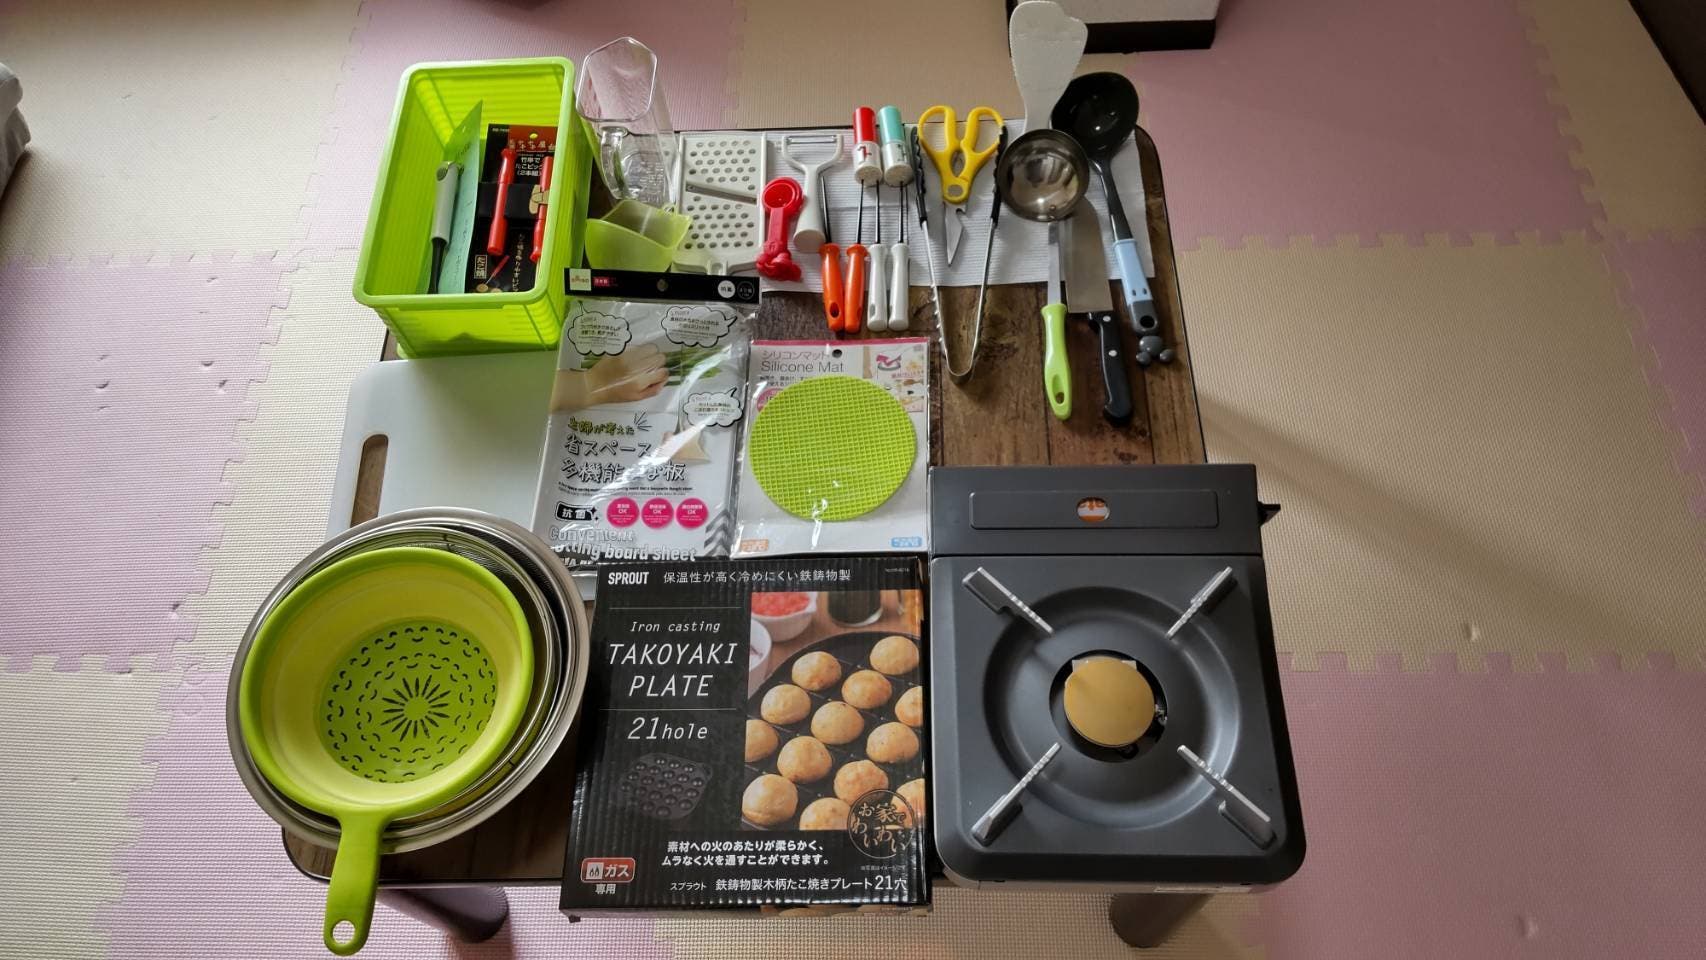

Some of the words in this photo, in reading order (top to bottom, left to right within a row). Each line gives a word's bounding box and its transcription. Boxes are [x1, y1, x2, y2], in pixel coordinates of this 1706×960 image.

[762, 350, 831, 361] シリコンマット
[760, 360, 814, 373] Silicone
[818, 361, 844, 373] Mat
[564, 433, 652, 457] 省スペース
[603, 543, 649, 561] board
[652, 544, 698, 562] sheet
[607, 571, 650, 585] SPROUT
[663, 569, 851, 584] 保温性が高く冷めにくい鉄鋳物製
[630, 621, 660, 632] Iron
[668, 620, 721, 633] casting
[609, 642, 738, 665] TAKOYAKI
[628, 673, 714, 697] PLATE
[667, 840, 824, 852] 素材への火のあたりが柔らかく、
[661, 853, 829, 866] ムラなく火を通すことができます。
[604, 864, 629, 878] ガス
[595, 883, 617, 895] 専用
[669, 882, 708, 891] スプラウト
